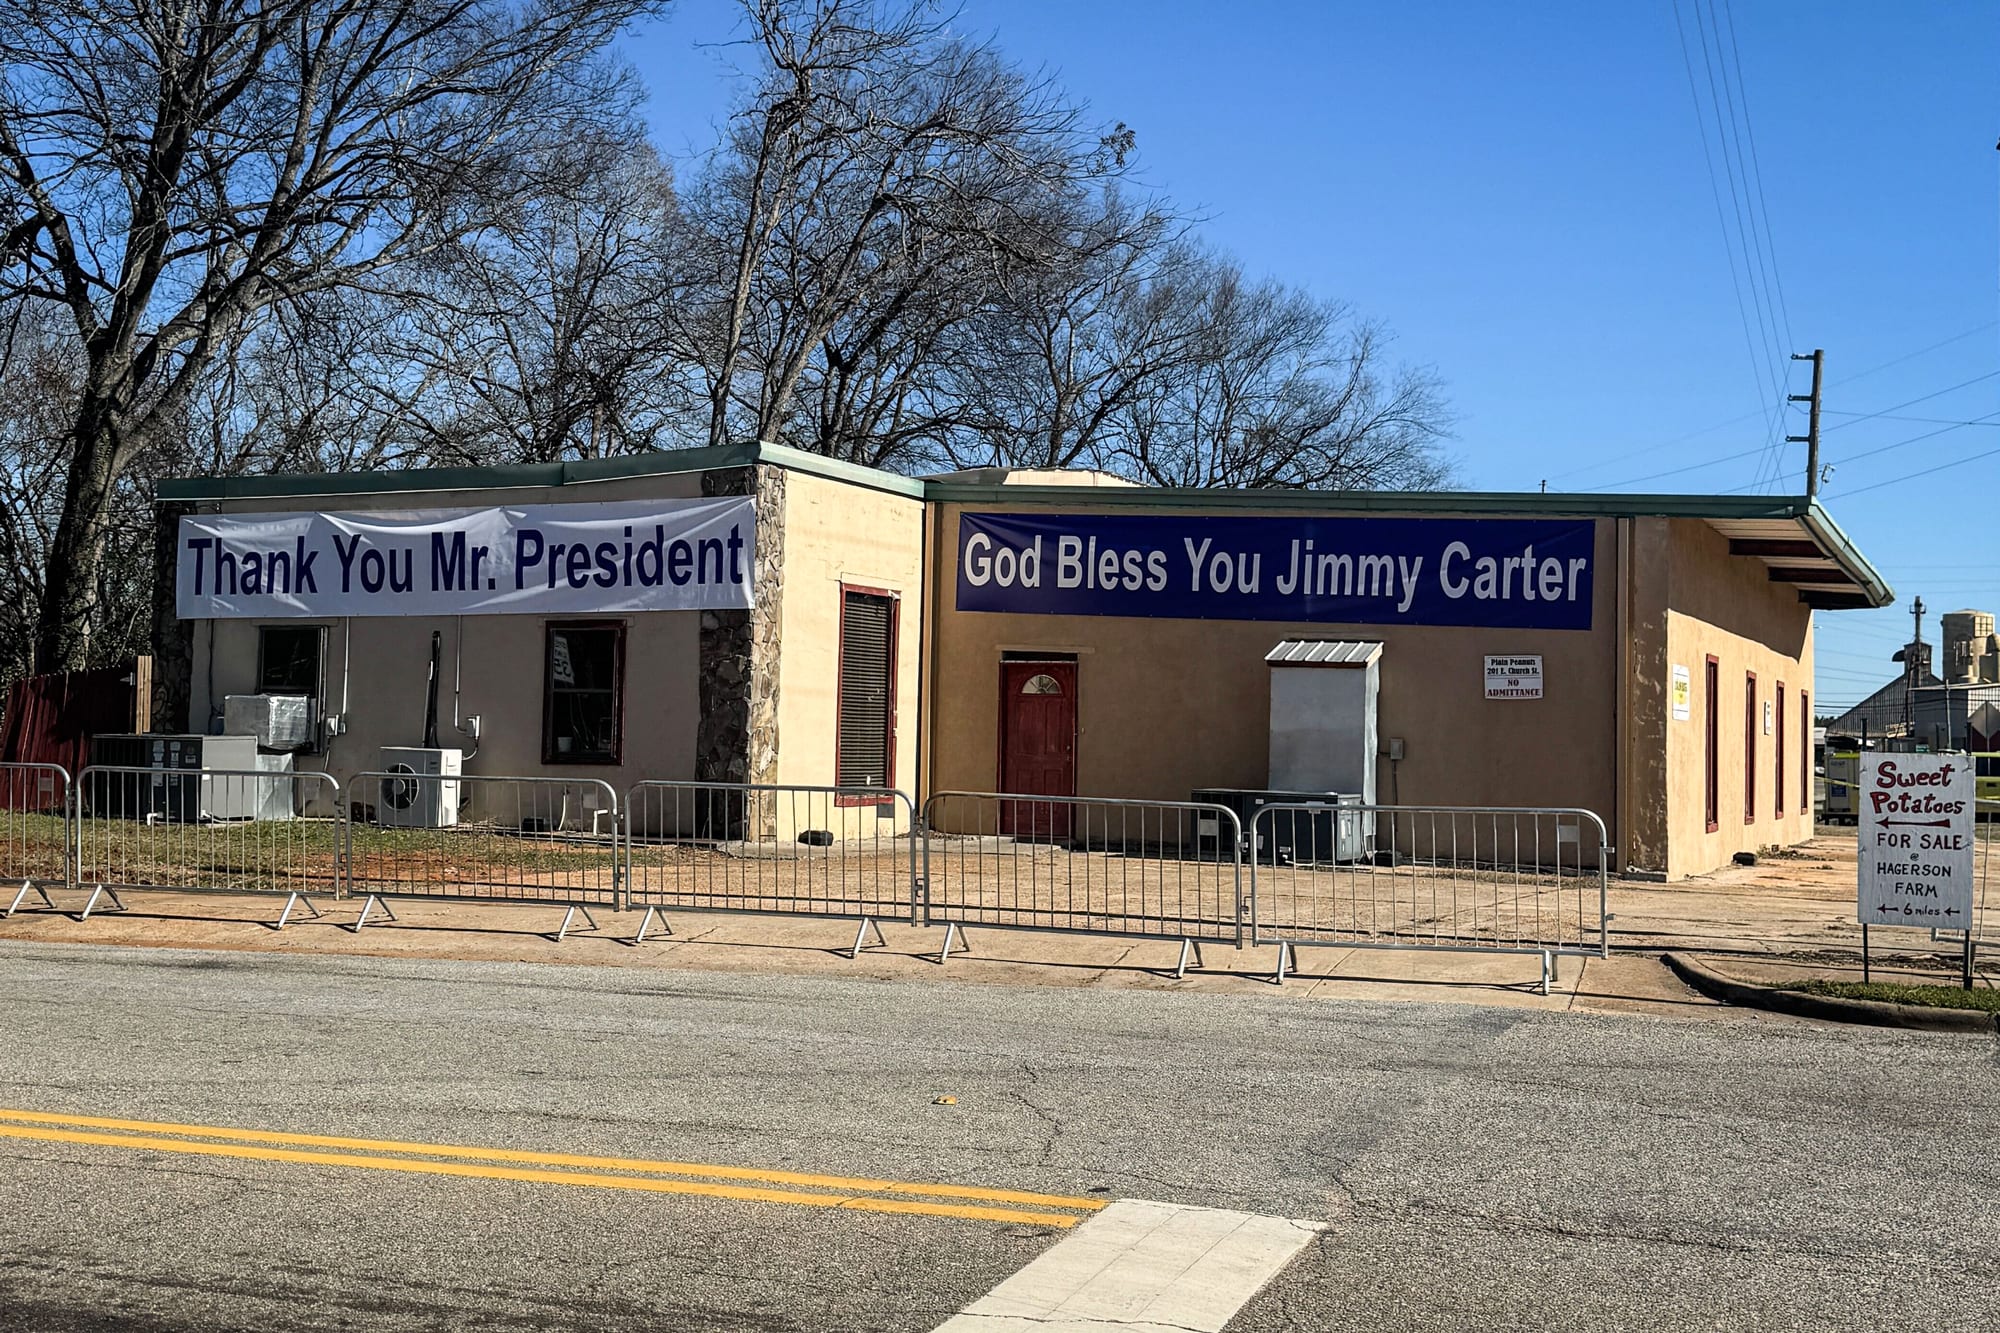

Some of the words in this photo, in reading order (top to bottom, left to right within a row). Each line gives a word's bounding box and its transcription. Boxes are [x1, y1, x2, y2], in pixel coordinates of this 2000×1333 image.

[187, 535, 320, 596] Thank
[332, 534, 414, 595] You
[431, 531, 496, 592] Mr.
[516, 522, 744, 590] President
[963, 532, 1040, 588] God
[1057, 534, 1168, 591] Bless
[1184, 537, 1261, 594] You
[1276, 538, 1423, 613] Jimmy
[1439, 541, 1587, 601] Carter
[1510, 658, 1536, 666] Peanuts
[1487, 667, 1498, 675] 201
[1508, 667, 1530, 675] Church
[1507, 679, 1520, 687] NO
[1487, 688, 1541, 697] ADMITTANCE
[1876, 761, 1955, 788] Sweet
[1870, 791, 1966, 815] Potatoes
[1877, 832, 1911, 849] FOR
[1920, 833, 1963, 850] SALE
[1877, 862, 1952, 877] HAGERSON
[1894, 882, 1938, 898] FARM
[1903, 902, 1913, 916] 6
[1914, 904, 1941, 916] miles
